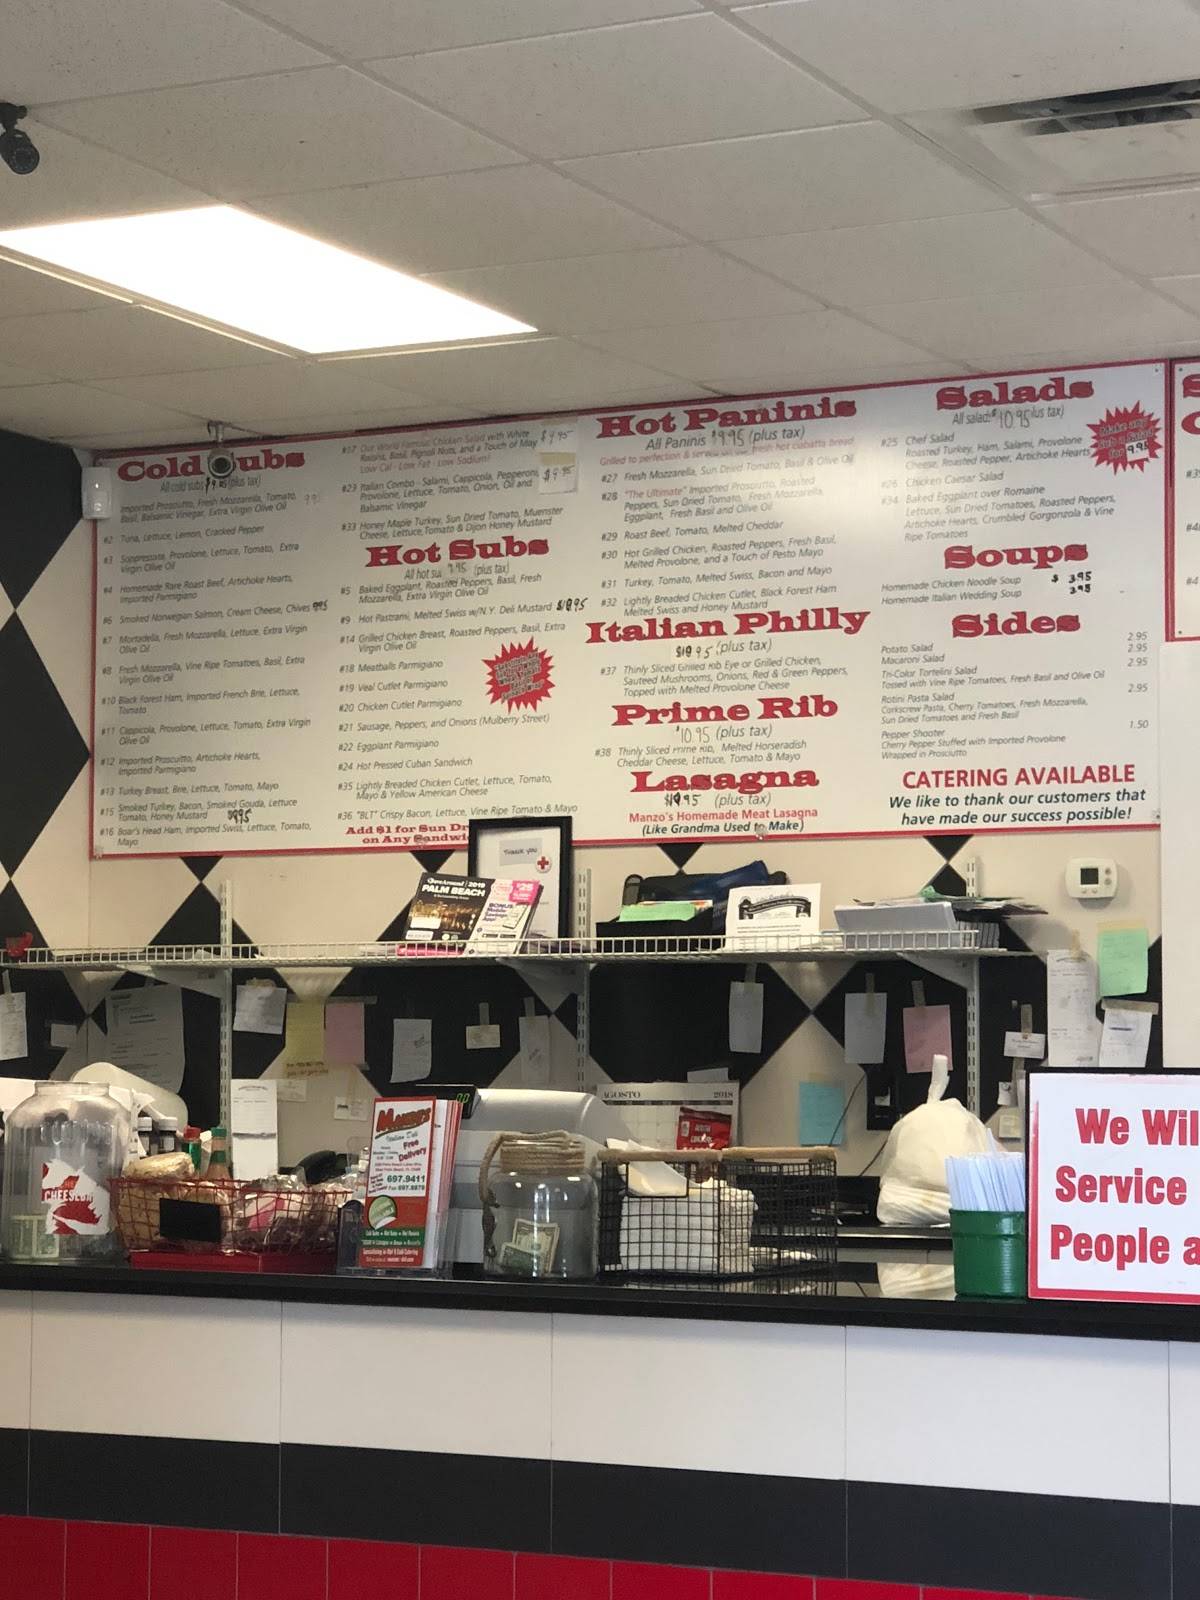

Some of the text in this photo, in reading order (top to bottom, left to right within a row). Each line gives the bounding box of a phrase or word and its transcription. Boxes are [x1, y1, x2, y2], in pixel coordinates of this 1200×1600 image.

[936, 377, 1094, 410] Salads
[595, 412, 677, 439] Hot
[683, 396, 857, 430] Paninis
[646, 436, 706, 450] All Paninis
[750, 426, 805, 445] (plus tax)
[118, 449, 305, 481] Cold ubs
[601, 532, 618, 541] #29
[624, 530, 648, 539] Roast
[675, 526, 709, 536] Tomato,
[712, 522, 744, 533] Melted
[746, 521, 783, 531] Cheddar
[365, 536, 550, 567] Hot Subs
[944, 543, 1089, 569] Soups
[881, 576, 1021, 591] Homemade Chicken Noodle Soup
[881, 589, 1022, 604] Homemade Italian Wedding Soup
[585, 607, 871, 644] Italian Philly
[952, 611, 1081, 638] Sides
[716, 638, 772, 656] (plus tax)
[880, 645, 908, 654] Potato
[911, 643, 934, 652] Salad
[339, 661, 443, 673] #18 Meatballs Parmigiano
[600, 666, 616, 676] #37
[624, 665, 648, 676] Thinly
[650, 663, 675, 673] Sliced
[724, 660, 740, 671] Eye
[741, 660, 752, 668] or
[754, 657, 783, 668] Grilled
[881, 656, 920, 664] Macaroni
[922, 653, 945, 663] Salad
[339, 680, 448, 692] #19 Veal Cutlet Parmigiano
[1127, 683, 1148, 693] 2.95
[611, 694, 838, 726] Prime Rib
[357, 722, 391, 732] Sausage,
[430, 718, 447, 727] and
[448, 718, 477, 727] Onions
[479, 716, 519, 726] (Mulberry
[521, 714, 550, 723] Street)
[716, 723, 772, 741] (plus tax)
[1129, 720, 1149, 729] 1.50
[630, 769, 819, 794] Lasagna
[903, 764, 1134, 788] CATERING AVAILABLE
[714, 792, 771, 809] (plus tax)
[889, 788, 1146, 808] We like to thank our customers that
[337, 811, 352, 820] #36
[356, 810, 378, 820] "BLT"
[379, 810, 404, 820] Crispy
[470, 806, 488, 815] Vine
[490, 806, 508, 816] Ripe
[511, 805, 543, 814] Tomato
[544, 804, 552, 813] &
[553, 804, 578, 814] Mayo
[629, 808, 818, 822] Manzo's Homemade Meat Lasagna
[901, 806, 1131, 824] have made our success possible!
[346, 823, 469, 835] Add $1 for Sun Dr
[642, 818, 804, 836] (Like Grandma Used to Make)
[362, 833, 469, 844] on Any Sandwi
[421, 884, 450, 894] PALM
[451, 887, 486, 897] BEACH
[468, 881, 486, 889] 2019
[604, 1090, 640, 1099] AGOSTO
[1075, 1108, 1130, 1145] We
[403, 1140, 419, 1150] Free
[398, 1147, 427, 1162] Delivery
[1055, 1165, 1187, 1205] Service
[1050, 1224, 1170, 1271] People
